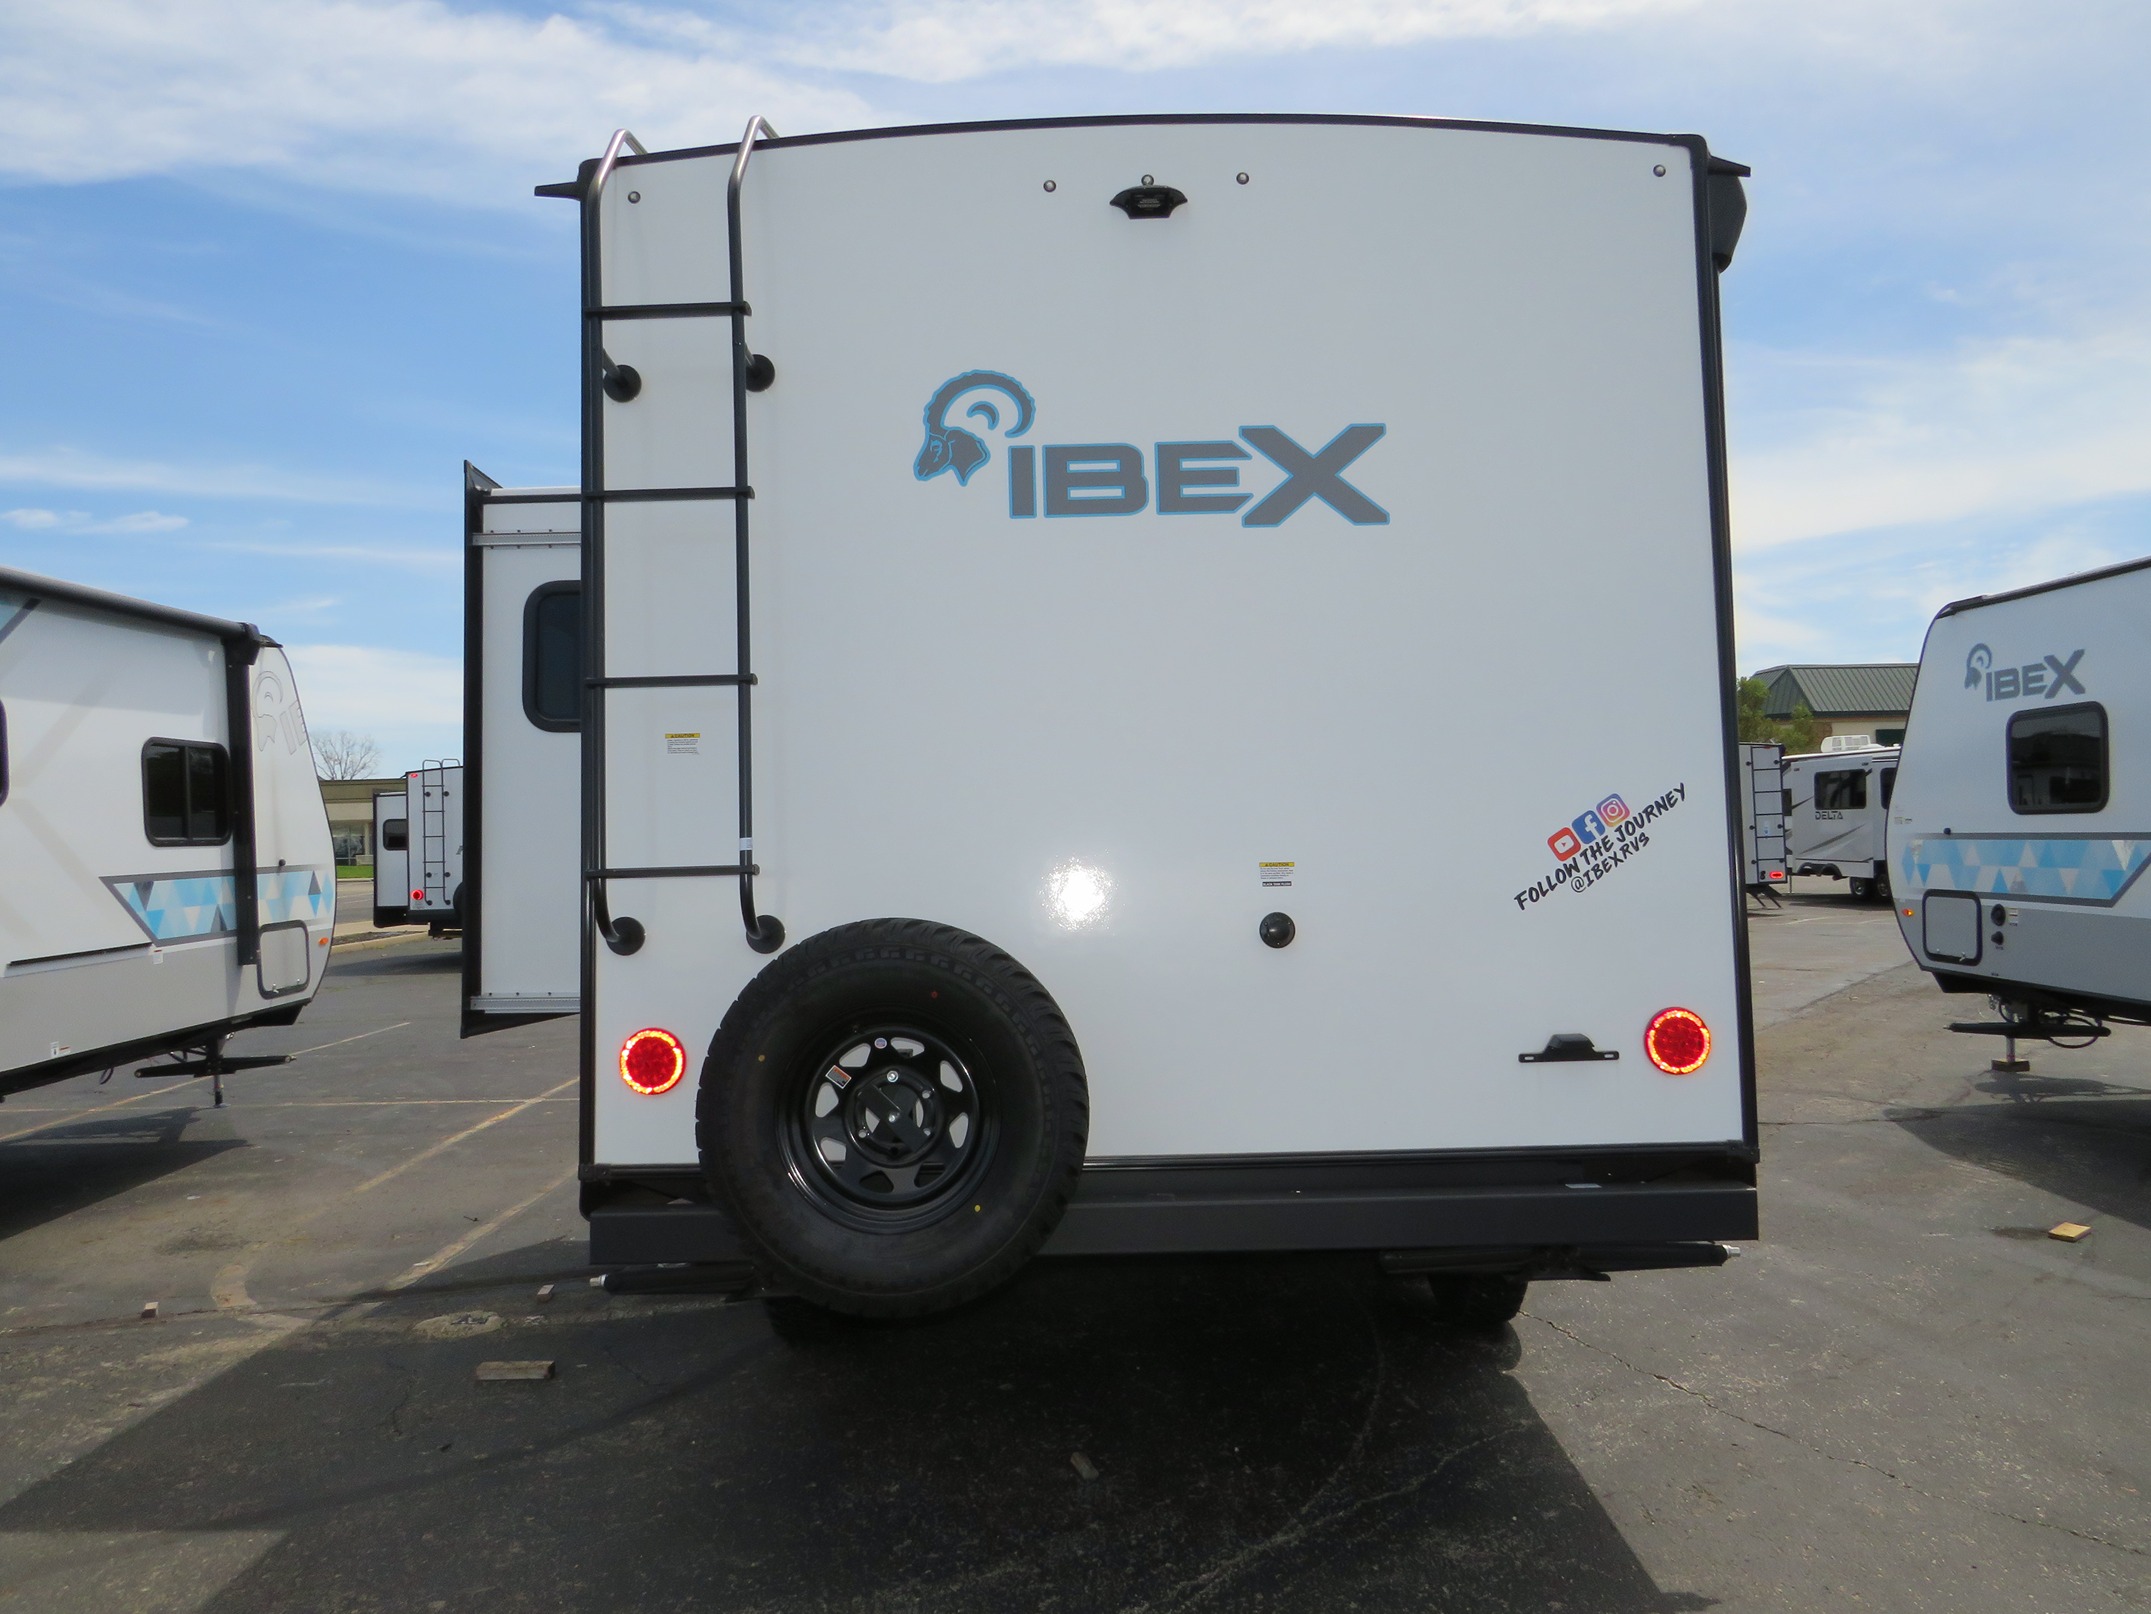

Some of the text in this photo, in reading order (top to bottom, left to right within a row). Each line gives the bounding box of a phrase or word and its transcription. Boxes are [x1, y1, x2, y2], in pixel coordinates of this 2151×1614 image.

[1007, 423, 1390, 528] IBEX
[1985, 648, 2087, 702] IBEX
[1815, 810, 1843, 820] DELTA
[1513, 782, 1687, 911] FOLLOW THE JOURNEY
[1570, 832, 1651, 893] @IBEXRVS
